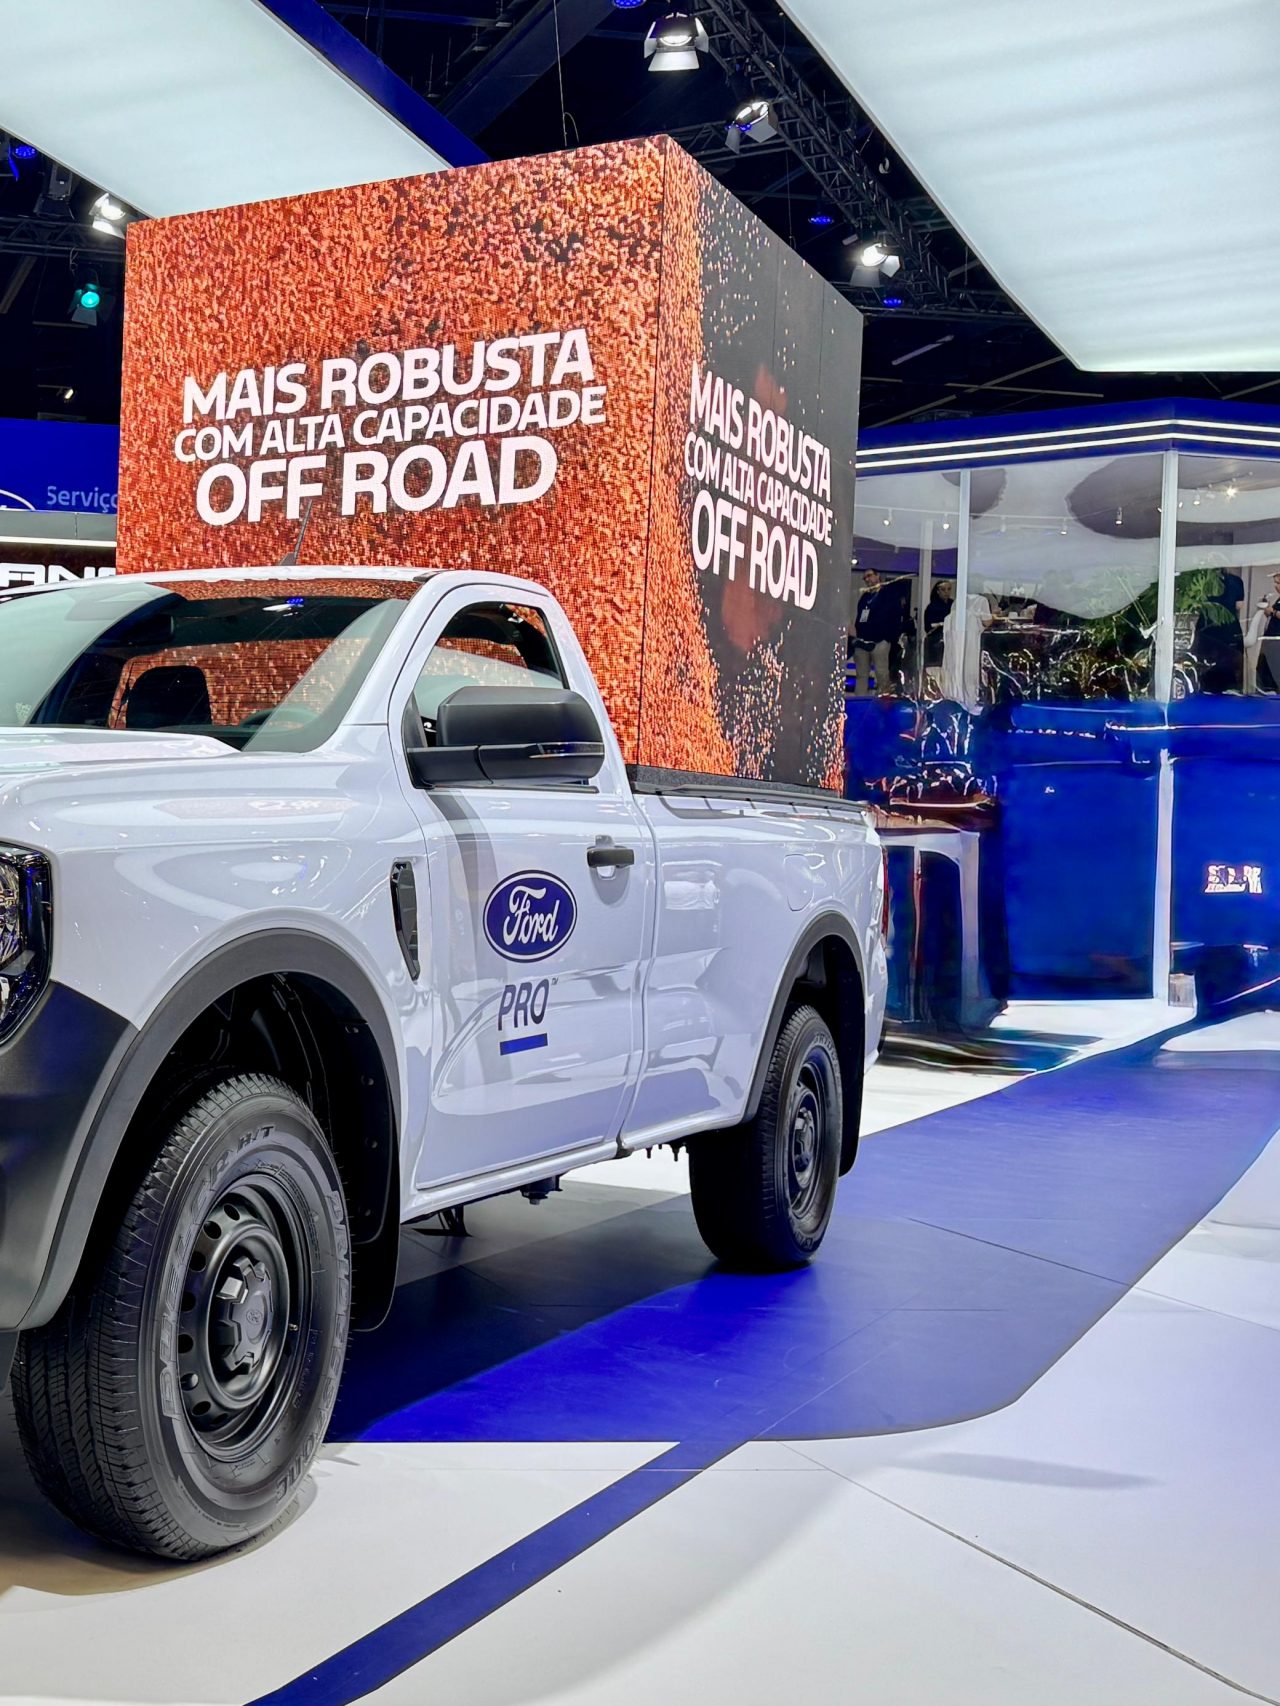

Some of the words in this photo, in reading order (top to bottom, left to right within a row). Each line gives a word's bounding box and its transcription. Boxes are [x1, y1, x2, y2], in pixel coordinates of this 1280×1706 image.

[183, 362, 307, 424] MAIS
[320, 328, 595, 410] ROBUSTA
[174, 422, 254, 463] COM
[260, 413, 346, 456] ALTA
[353, 385, 608, 446] CAPACIDADE
[689, 359, 744, 450] MAIS
[747, 397, 831, 503] ROBUSTA
[196, 454, 327, 526] OFF
[341, 435, 558, 516] ROAD
[684, 431, 721, 490] COM
[721, 452, 755, 508] ALTA
[756, 471, 833, 547] CAPACIDADE
[692, 489, 747, 581] OFF
[749, 513, 818, 611] ROAD
[503, 885, 560, 946] Ford
[498, 979, 549, 1031] PRO
